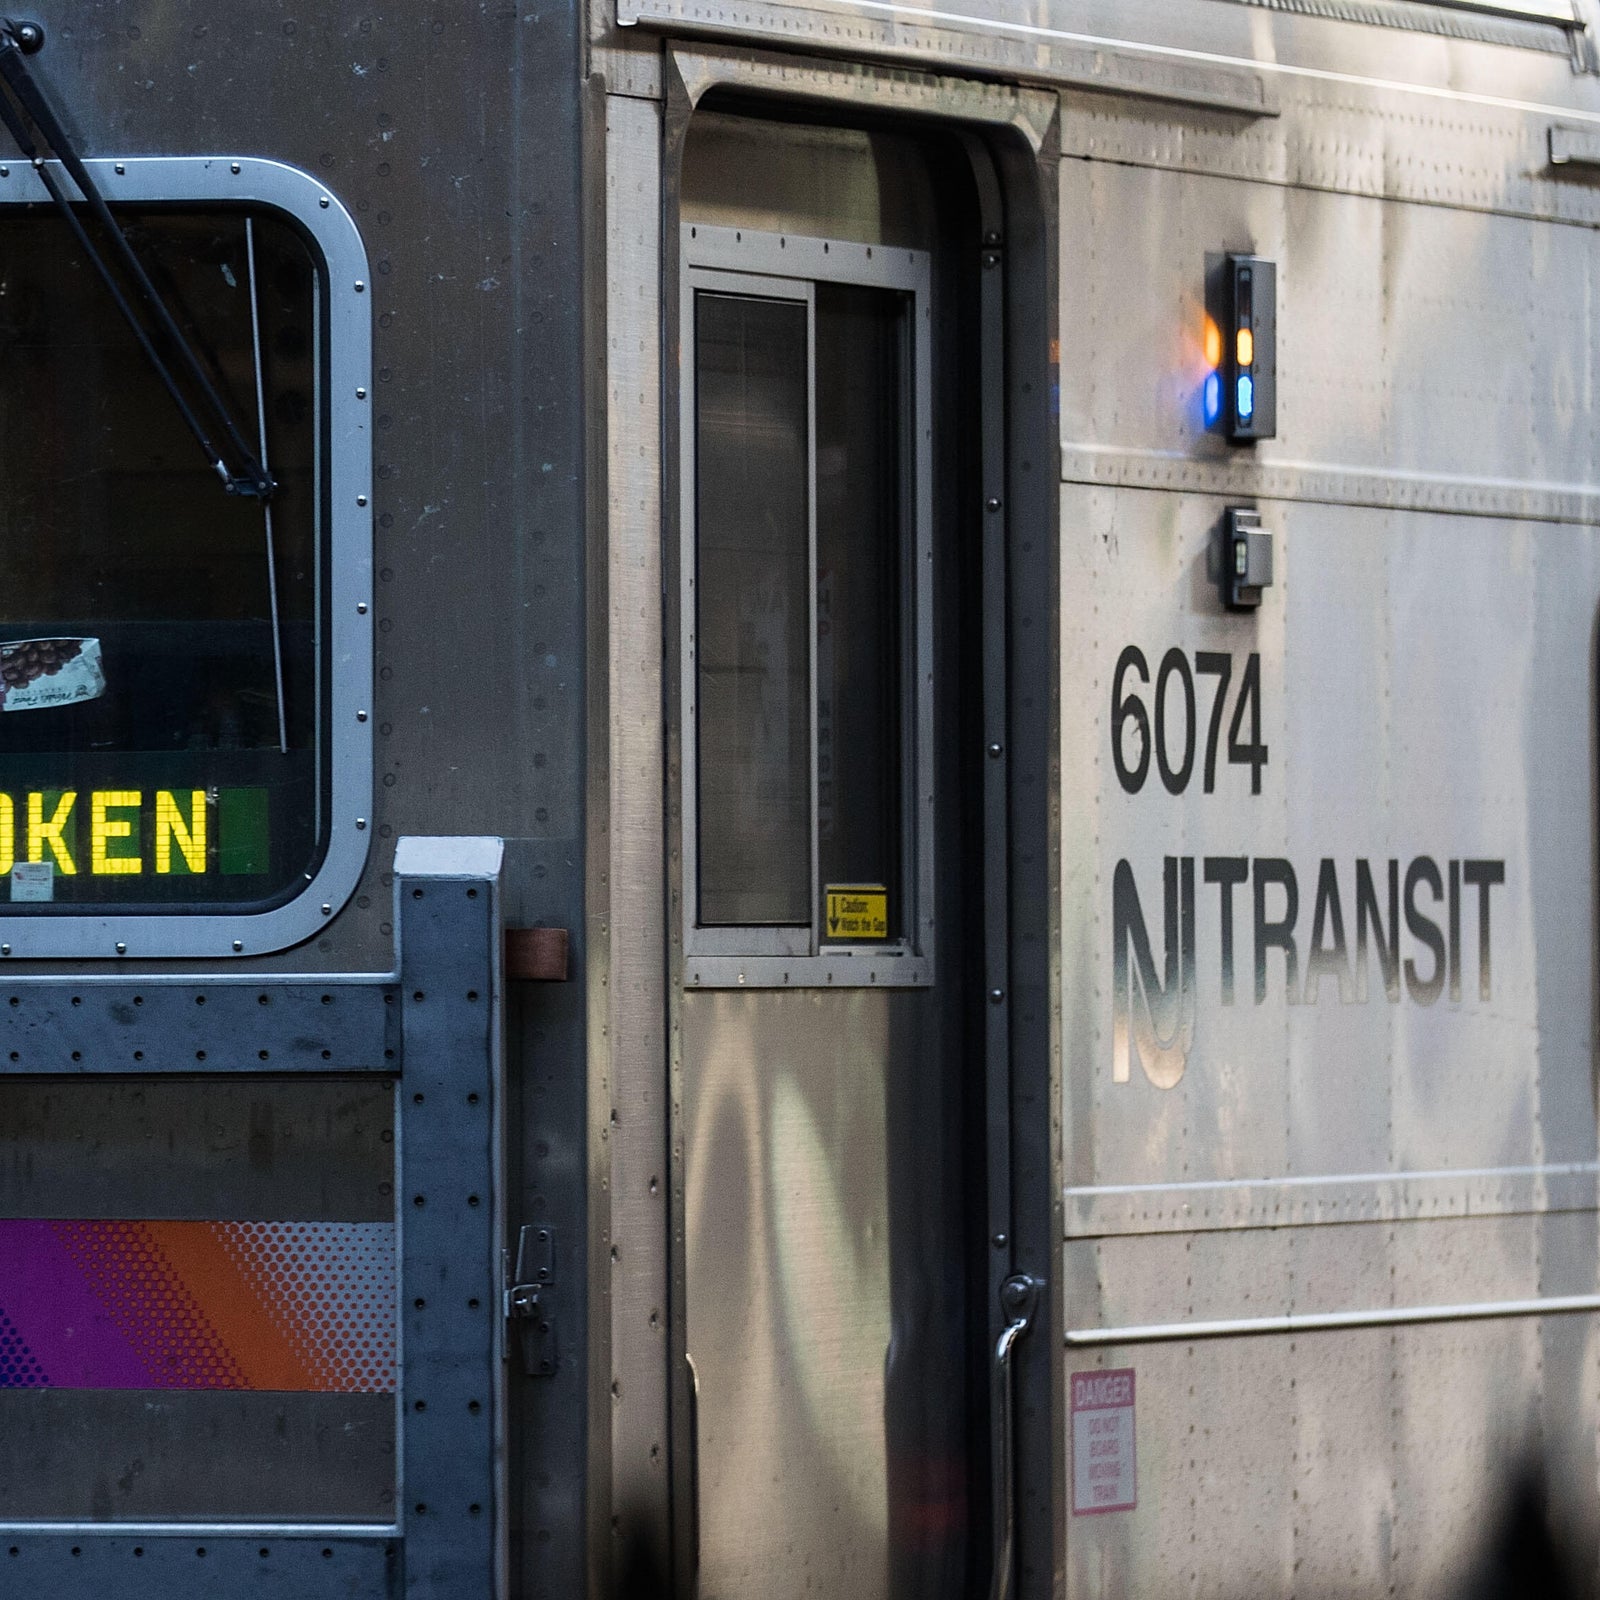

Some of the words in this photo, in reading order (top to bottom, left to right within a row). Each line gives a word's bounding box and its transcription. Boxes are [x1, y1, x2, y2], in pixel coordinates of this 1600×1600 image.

[1111, 645, 1268, 796] 6074
[0, 790, 207, 875] KEN
[1203, 855, 1506, 1007] TRANSIT
[1075, 1375, 1132, 1407] DANGER
